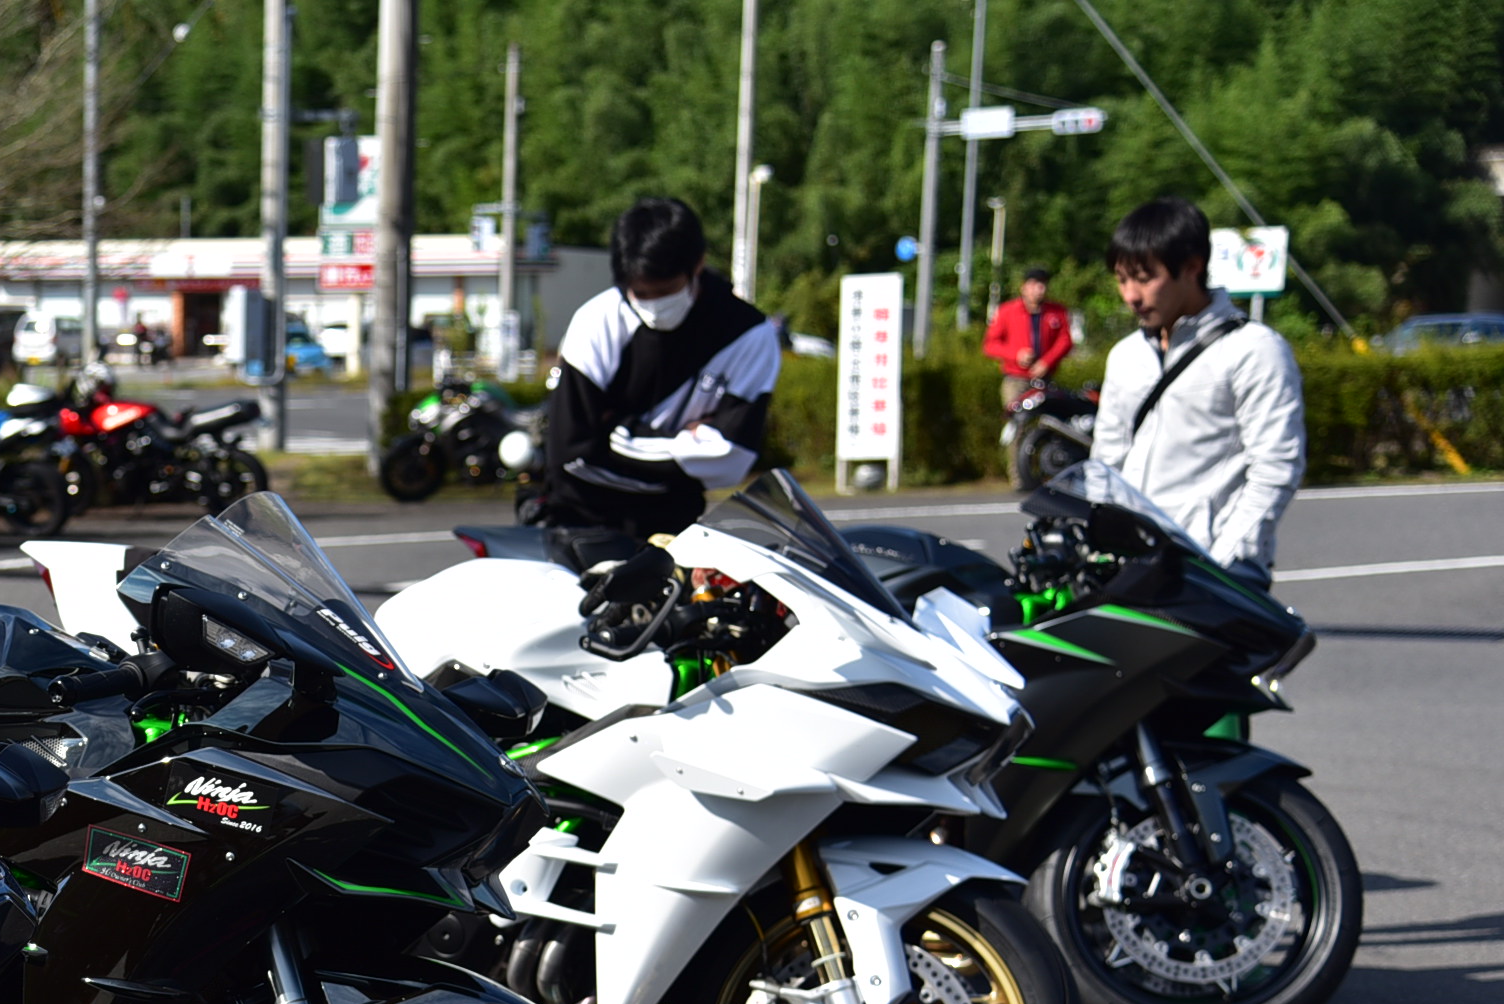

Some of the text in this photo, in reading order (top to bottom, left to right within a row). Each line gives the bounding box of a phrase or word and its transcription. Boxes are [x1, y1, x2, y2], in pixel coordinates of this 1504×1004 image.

[184, 776, 258, 804] Ninja
[197, 796, 239, 819] H2OC
[239, 821, 262, 833] 2016
[102, 840, 172, 868] Ninja
[116, 860, 152, 882] H2OC
